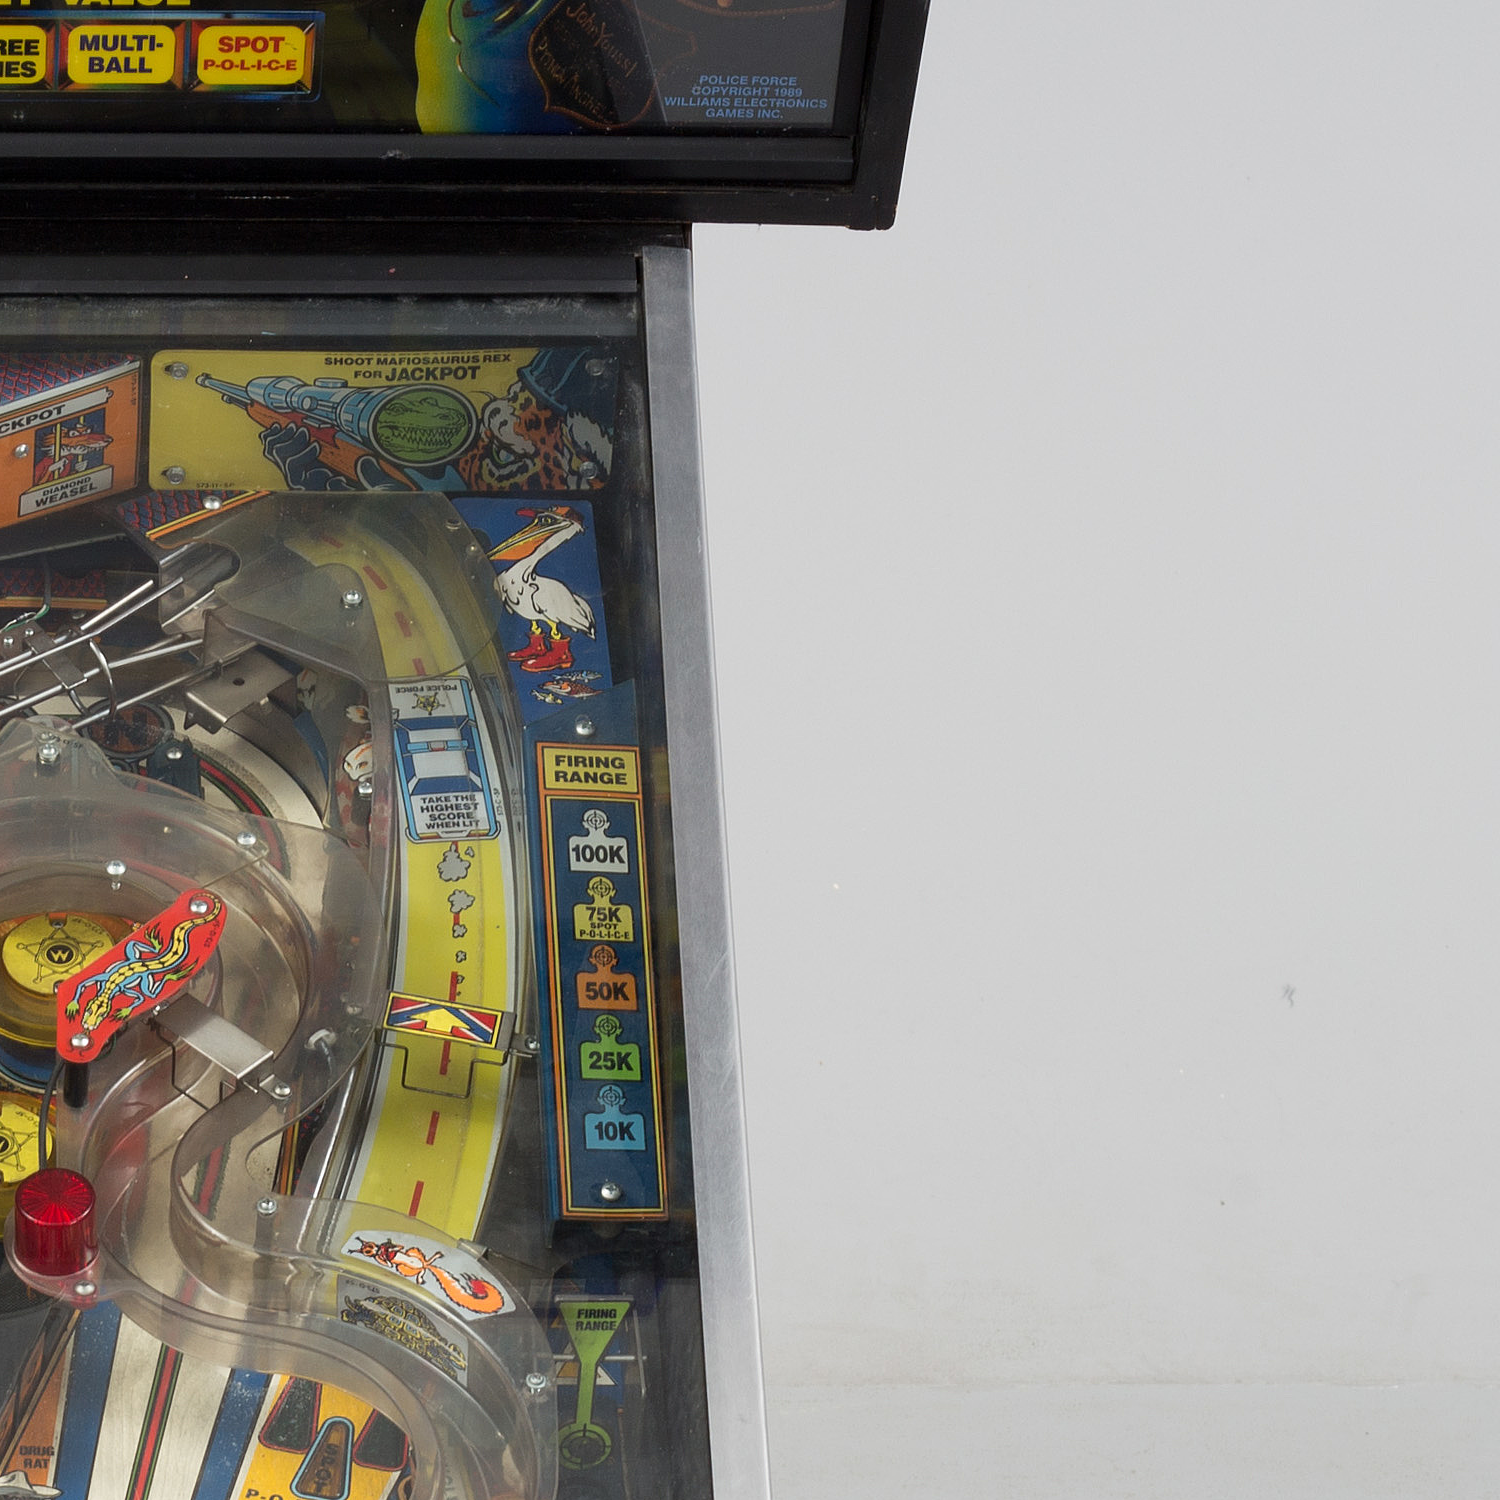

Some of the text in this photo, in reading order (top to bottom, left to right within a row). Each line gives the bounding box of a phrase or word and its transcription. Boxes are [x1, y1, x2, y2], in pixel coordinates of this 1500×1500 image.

[79, 34, 164, 52] MULTI-
[218, 36, 286, 53] SPOT
[88, 56, 153, 74] BALL
[203, 59, 298, 71] P-O-L-I-C-E
[700, 75, 798, 87] POLICE FORCE
[691, 86, 803, 97] COPYRIGHT 1989
[664, 96, 828, 109] WILLIAMS ELECTRONICS
[705, 107, 784, 120] GAMES INC.
[324, 353, 511, 367] SHOOT MAFIOSAURUS REX
[353, 365, 481, 383] FOR JACKPOT
[42, 475, 93, 498] DIAMOND
[34, 482, 99, 510] WEASEL
[554, 754, 626, 770] FIRING
[554, 770, 628, 786] RANGE
[420, 794, 453, 805] TAKE
[419, 802, 480, 814] HIGHEST
[428, 811, 474, 822] SCORE
[424, 820, 462, 830] WHEN
[571, 844, 627, 865] 100K
[585, 905, 623, 924] 75K
[589, 922, 619, 931] SPOT
[585, 981, 631, 1002] 50K
[588, 1051, 635, 1072] 25K
[594, 1121, 637, 1142] 10K
[576, 1307, 618, 1320] FIRING
[575, 1319, 617, 1332] RANGE
[19, 1444, 55, 1457] DRUG
[23, 1457, 51, 1470] RAT
[314, 1443, 339, 1494] SPOT
